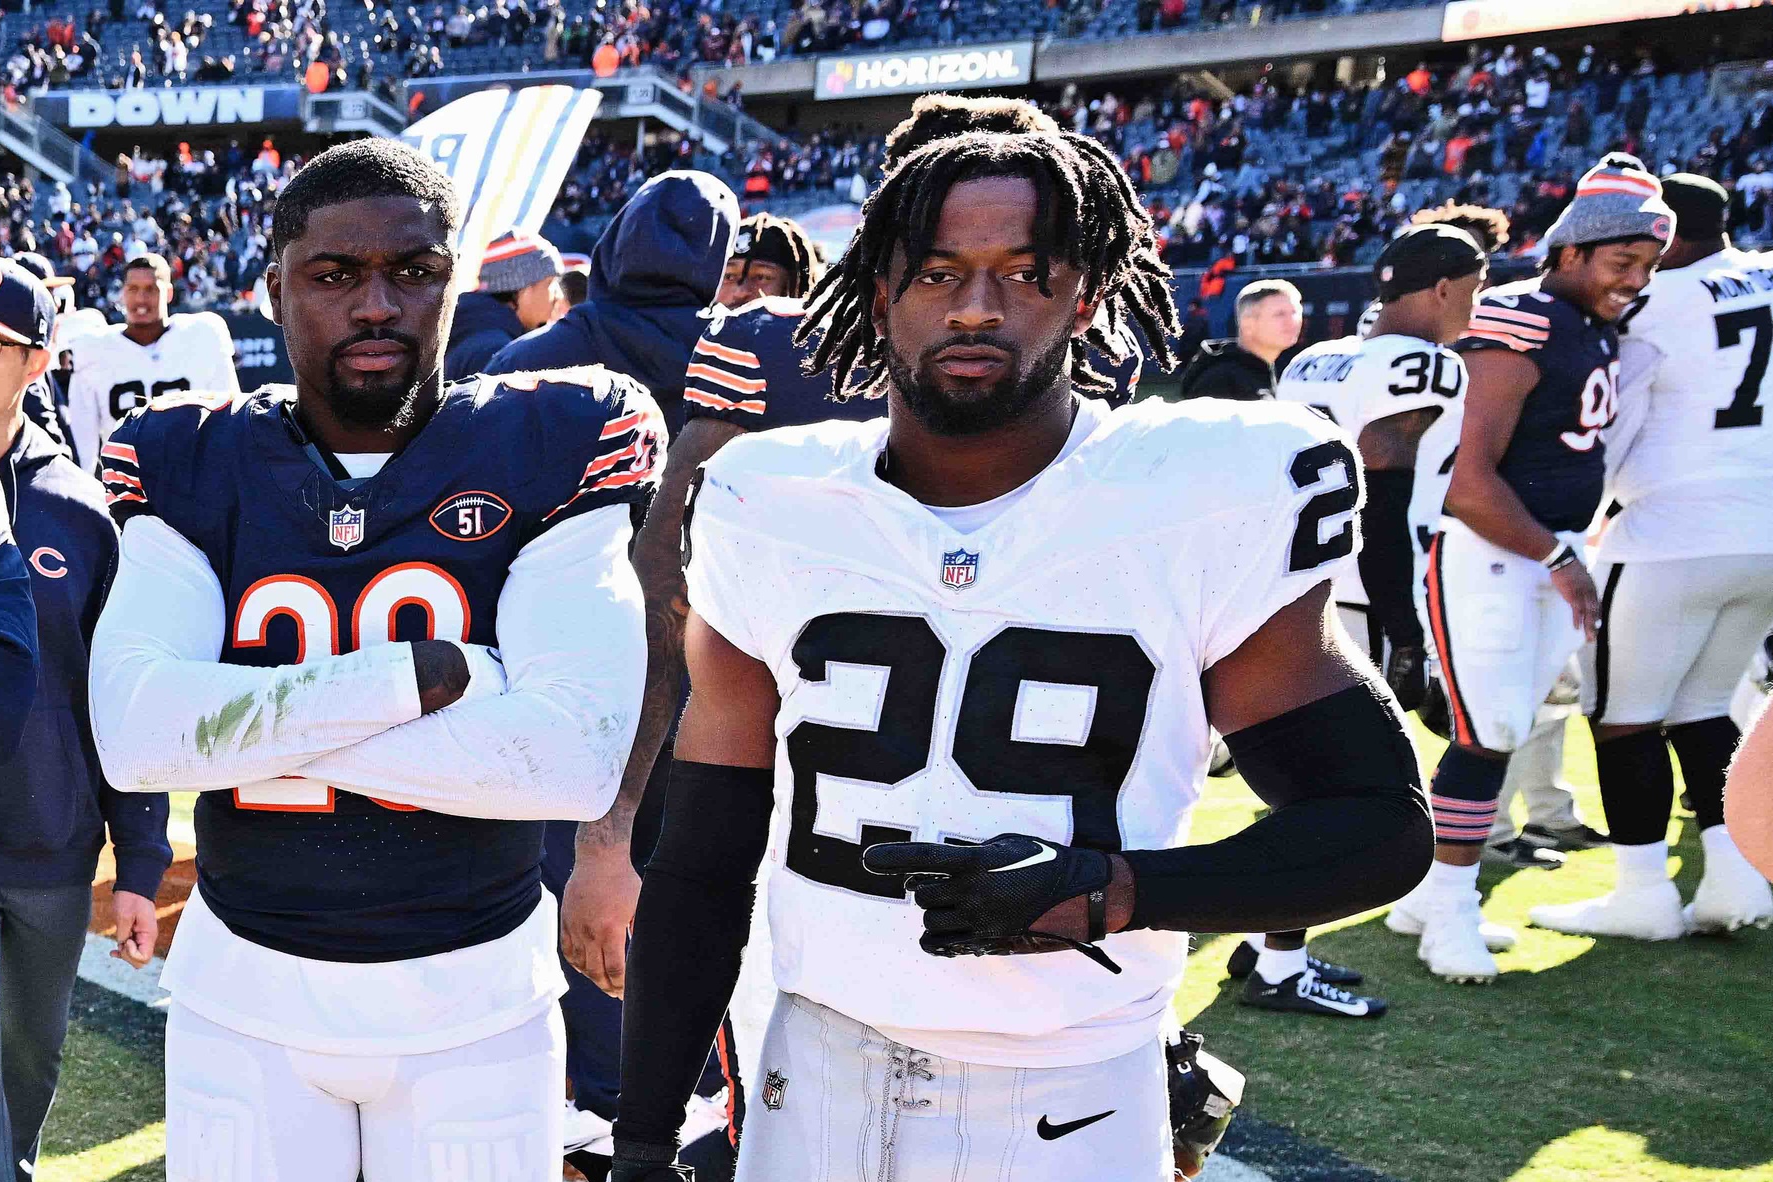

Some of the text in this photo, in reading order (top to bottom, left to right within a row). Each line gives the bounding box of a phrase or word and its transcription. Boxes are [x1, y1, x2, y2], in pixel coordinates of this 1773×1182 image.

[68, 89, 264, 127] DOWN
[1388, 351, 1462, 398] 30
[1713, 305, 1773, 430] 7
[458, 506, 483, 536] 51
[944, 566, 973, 584] NFL
[783, 611, 1164, 904] 29
